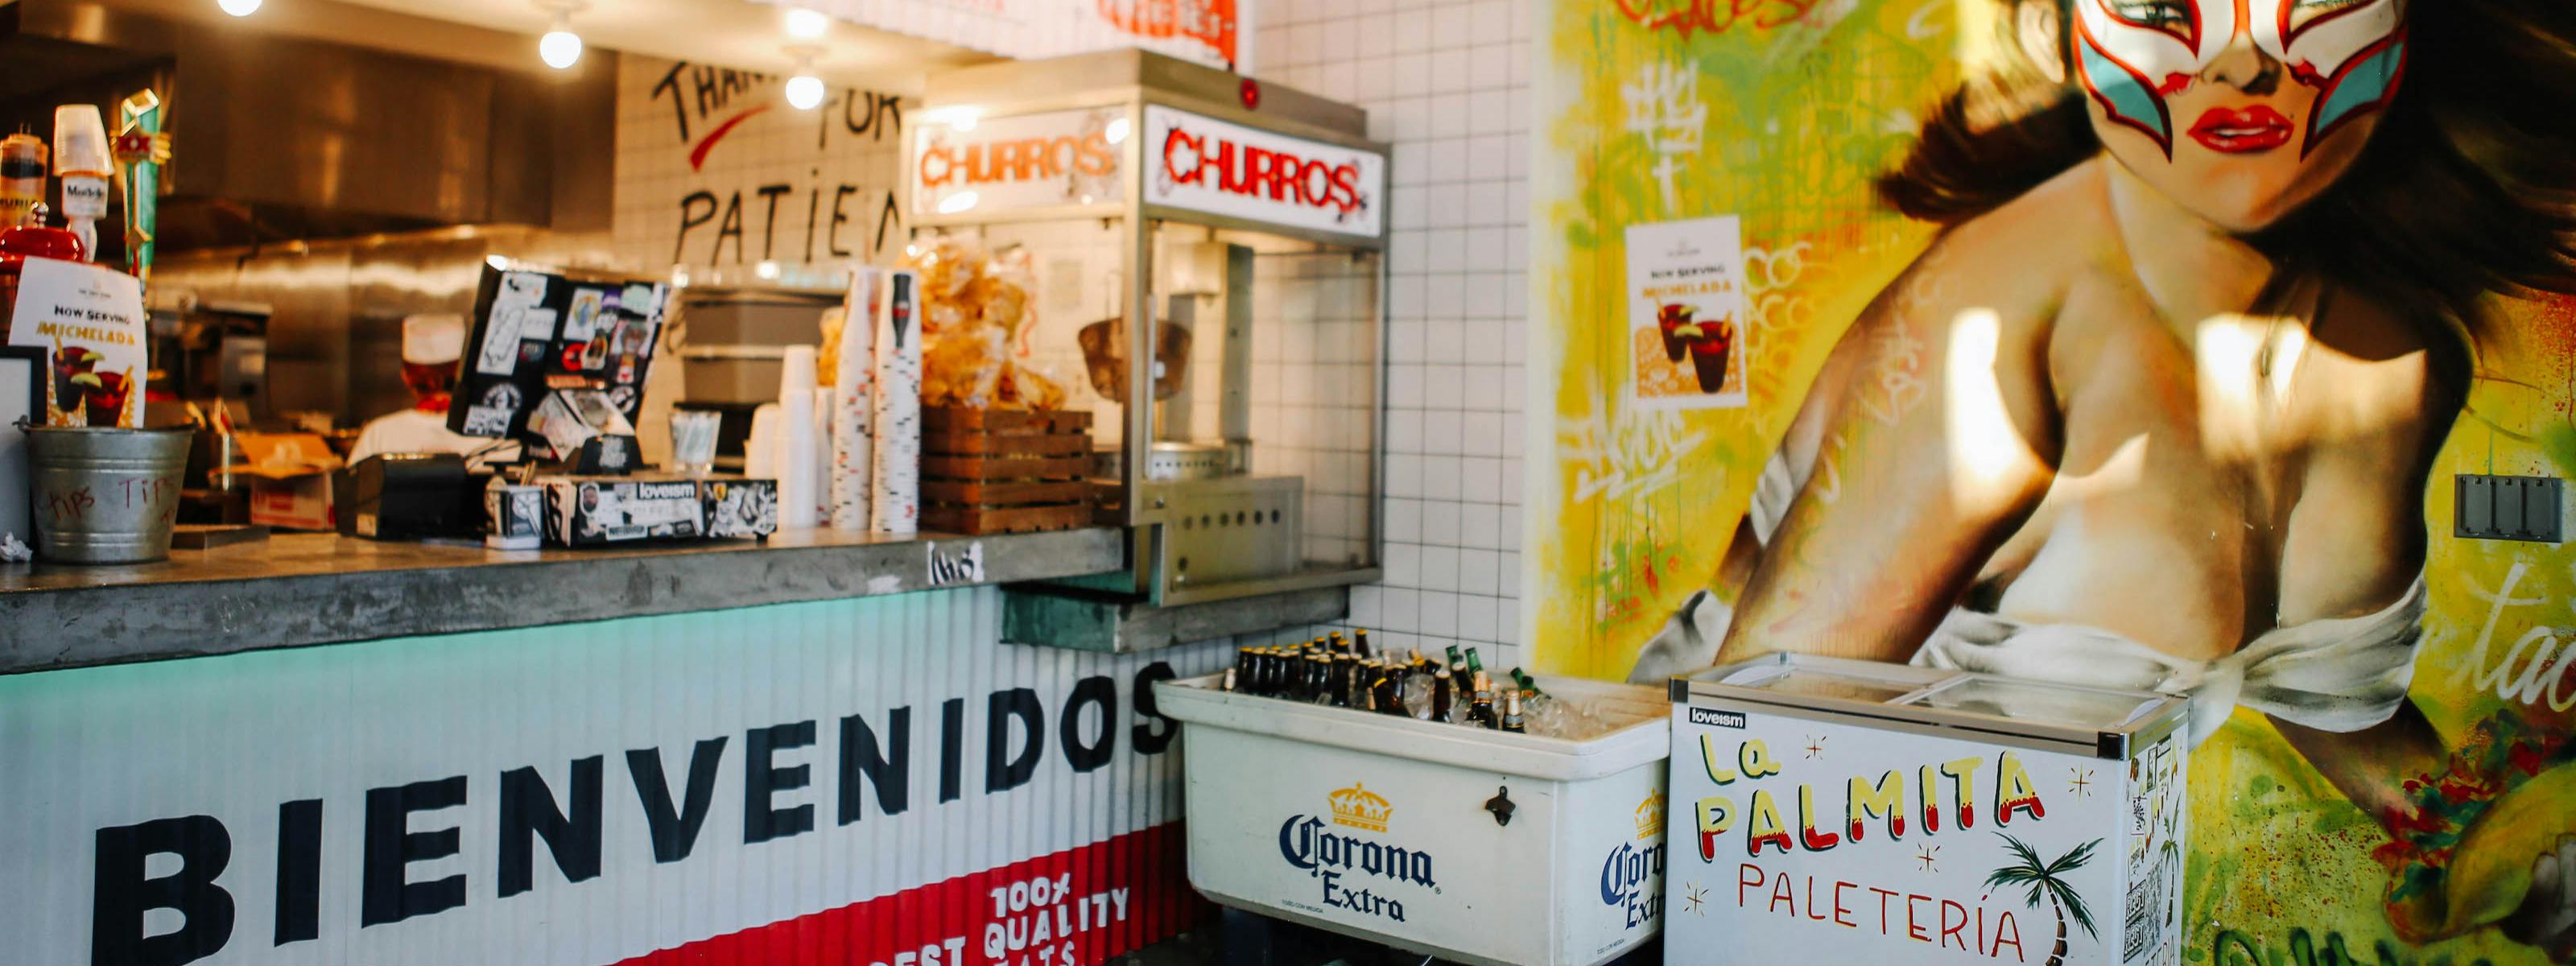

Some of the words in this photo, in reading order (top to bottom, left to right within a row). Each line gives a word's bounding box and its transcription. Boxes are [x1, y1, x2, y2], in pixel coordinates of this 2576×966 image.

[920, 130, 1117, 188] CHURROS
[1164, 126, 1362, 213] CHURROS
[36, 321, 135, 347] MICHELADA
[54, 304, 84, 319] NOW
[86, 310, 130, 325] SERVING
[639, 482, 696, 500] loveism
[1691, 708, 1744, 728] loveism
[1699, 733, 1782, 786] La
[90, 660, 1179, 966] BIENVENIDOS
[1695, 749, 2046, 865] PALMITA
[1279, 814, 1437, 889] Corona
[990, 872, 1071, 919] 100%
[1321, 869, 1406, 923] Extra
[1738, 863, 2025, 963] PALETERÍA
[983, 886, 1129, 960] QUALITY
[869, 935, 966, 966] EST
